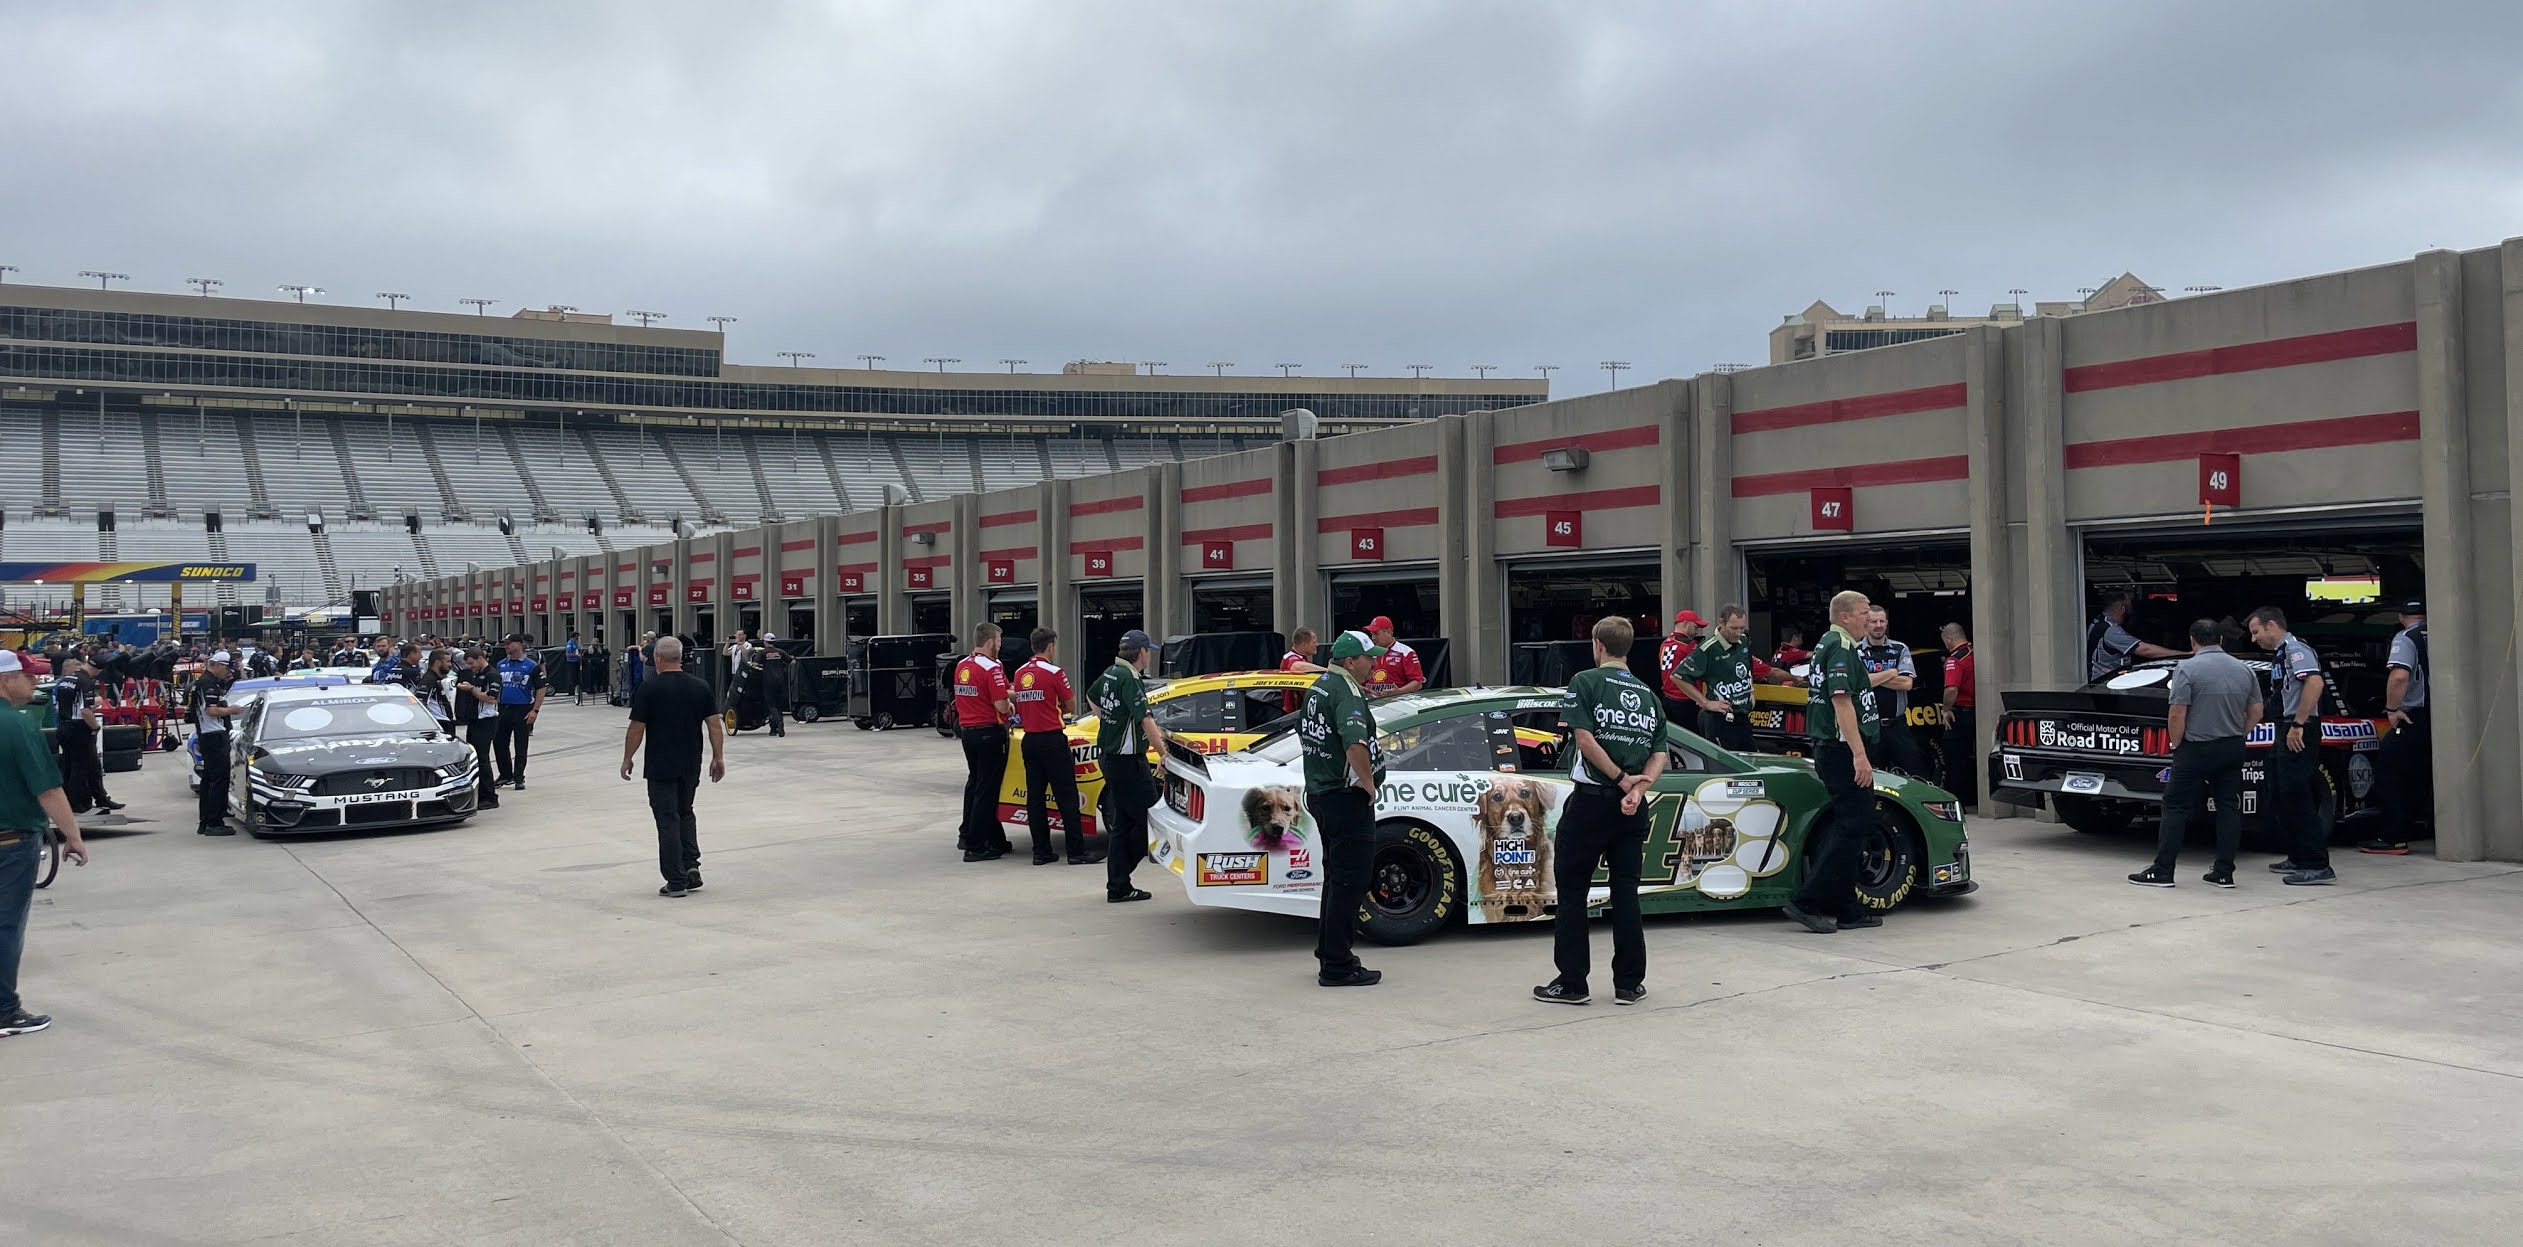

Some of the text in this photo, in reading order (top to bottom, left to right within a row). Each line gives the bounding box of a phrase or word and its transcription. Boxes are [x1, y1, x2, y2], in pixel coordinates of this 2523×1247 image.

[2209, 471, 2228, 490] 49
[1821, 501, 1841, 518] 47
[1554, 521, 1572, 535] 45
[1358, 538, 1375, 550] 43
[1209, 549, 1224, 560] 41
[1092, 559, 1106, 569] 39
[180, 566, 245, 578] SUNOCO
[913, 573, 926, 582] 35
[994, 567, 1008, 577] 37
[786, 583, 797, 591] 31
[845, 578, 857, 587] 33
[692, 590, 703, 598] 27
[736, 587, 748, 595] 29
[310, 697, 379, 706] ALMIROLA
[1516, 701, 1558, 709] BRISCOE
[1596, 708, 1656, 732] one cure
[2070, 722, 2140, 735] Official Motor Oil of
[2057, 730, 2140, 754] Road Trips
[2353, 740, 2378, 750] .com
[2009, 764, 2018, 778] 1
[2241, 768, 2265, 784] Trips
[334, 791, 421, 804] MUSTANG
[1422, 783, 1477, 804] cure
[1495, 840, 1524, 851] HIGH
[1205, 853, 1262, 873] RUSH
[1495, 852, 1531, 863] POINT
[1210, 872, 1256, 881] TRUCK CENTERS
[1408, 827, 1455, 918] GOODYEAR
